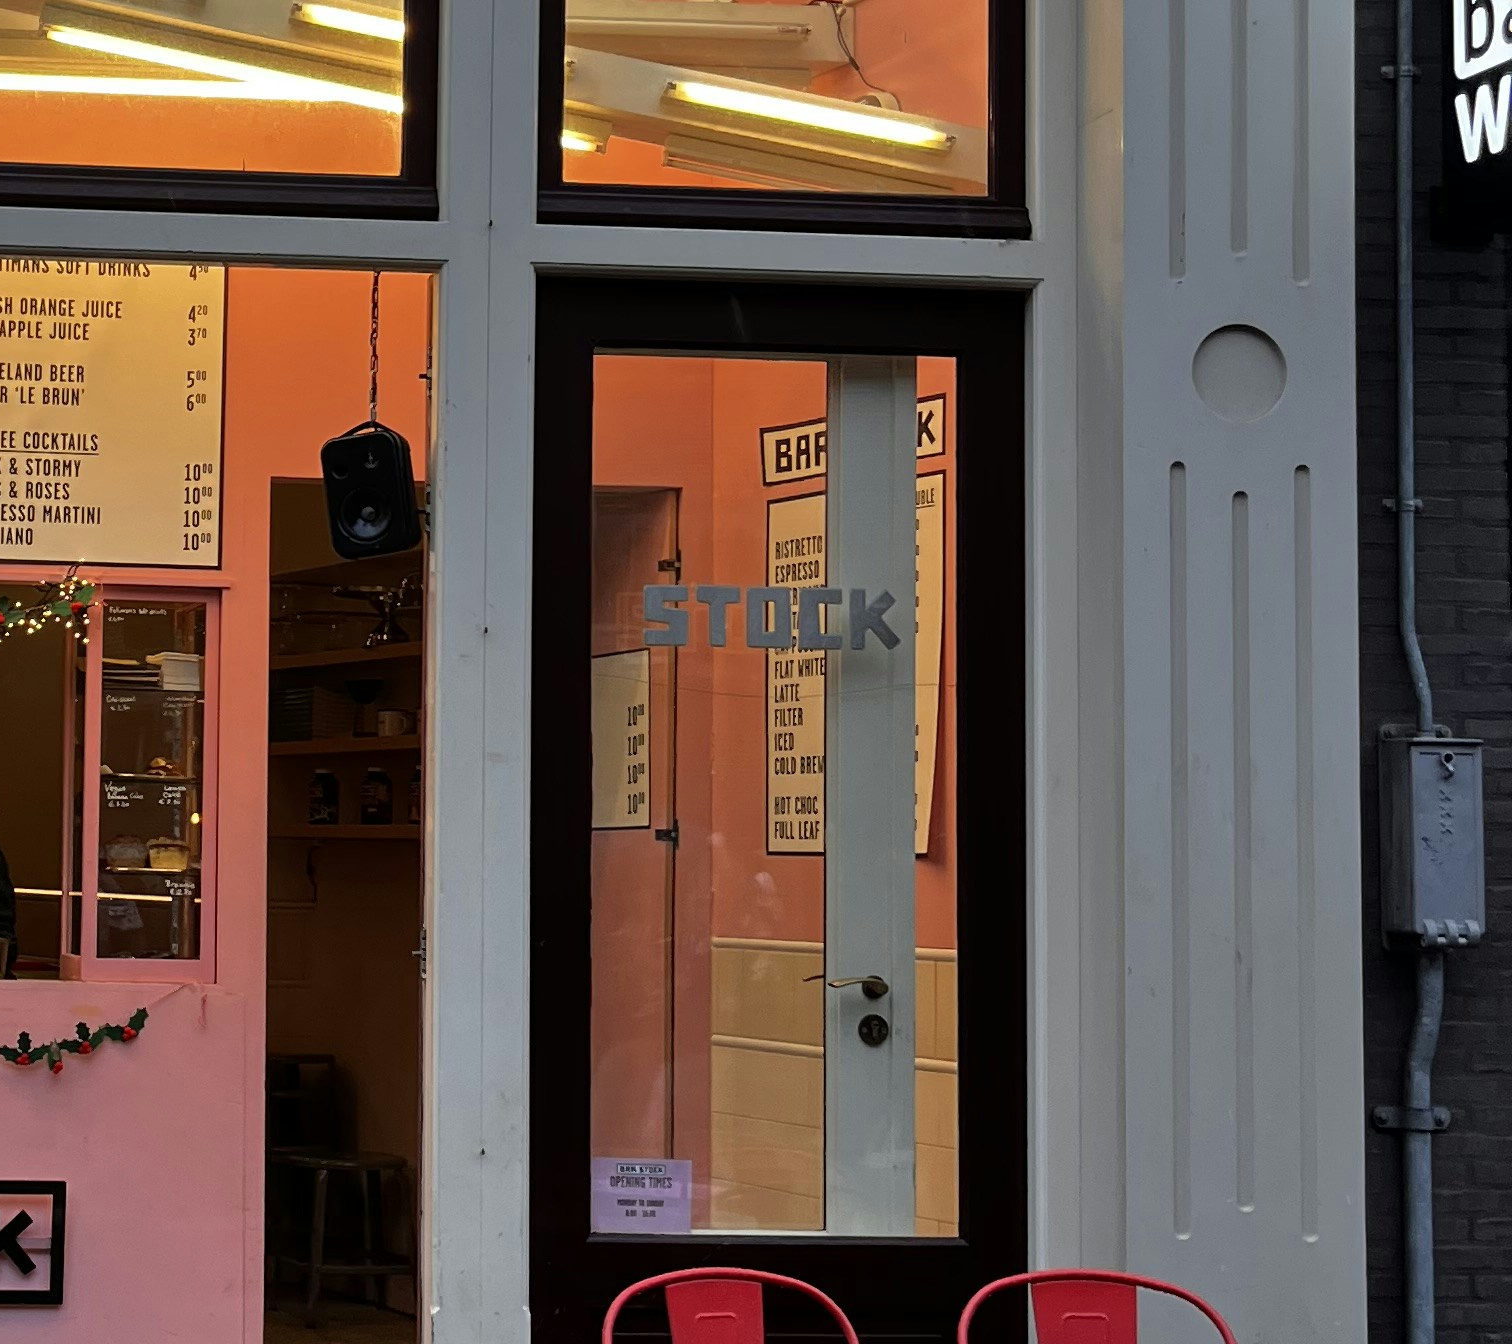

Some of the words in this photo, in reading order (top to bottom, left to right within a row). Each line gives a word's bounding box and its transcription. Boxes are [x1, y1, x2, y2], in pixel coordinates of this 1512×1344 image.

[56, 260, 89, 276] SOFT
[98, 262, 151, 278] DRINKS
[20, 297, 75, 317] ORANGE
[82, 300, 123, 319] JUICE
[0, 320, 42, 339] APPLE
[49, 322, 90, 341] JUICE
[50, 364, 84, 383] BEER
[23, 431, 99, 451] COCKTAILS
[9, 457, 18, 475] &
[25, 458, 81, 477] STORMY
[9, 480, 18, 498] &
[26, 481, 70, 500] ROSES
[915, 487, 935, 505] UBLE
[43, 505, 101, 524] MARTINI
[775, 535, 823, 561] RISTRETTO
[775, 560, 820, 584] ESPRESSO
[643, 584, 902, 651] STOCK
[774, 659, 794, 680] FLAT
[798, 657, 825, 678] WHITE
[774, 683, 800, 704] LATTE
[774, 707, 803, 728] FILTER
[774, 732, 795, 751] ICED
[774, 756, 796, 775] COLD
[774, 796, 791, 815] HOT
[794, 796, 819, 815] CHOC
[774, 821, 795, 840] FULL
[798, 820, 820, 840] LEAF
[609, 1176, 646, 1189] OPENING
[648, 1176, 673, 1189] TIMES
